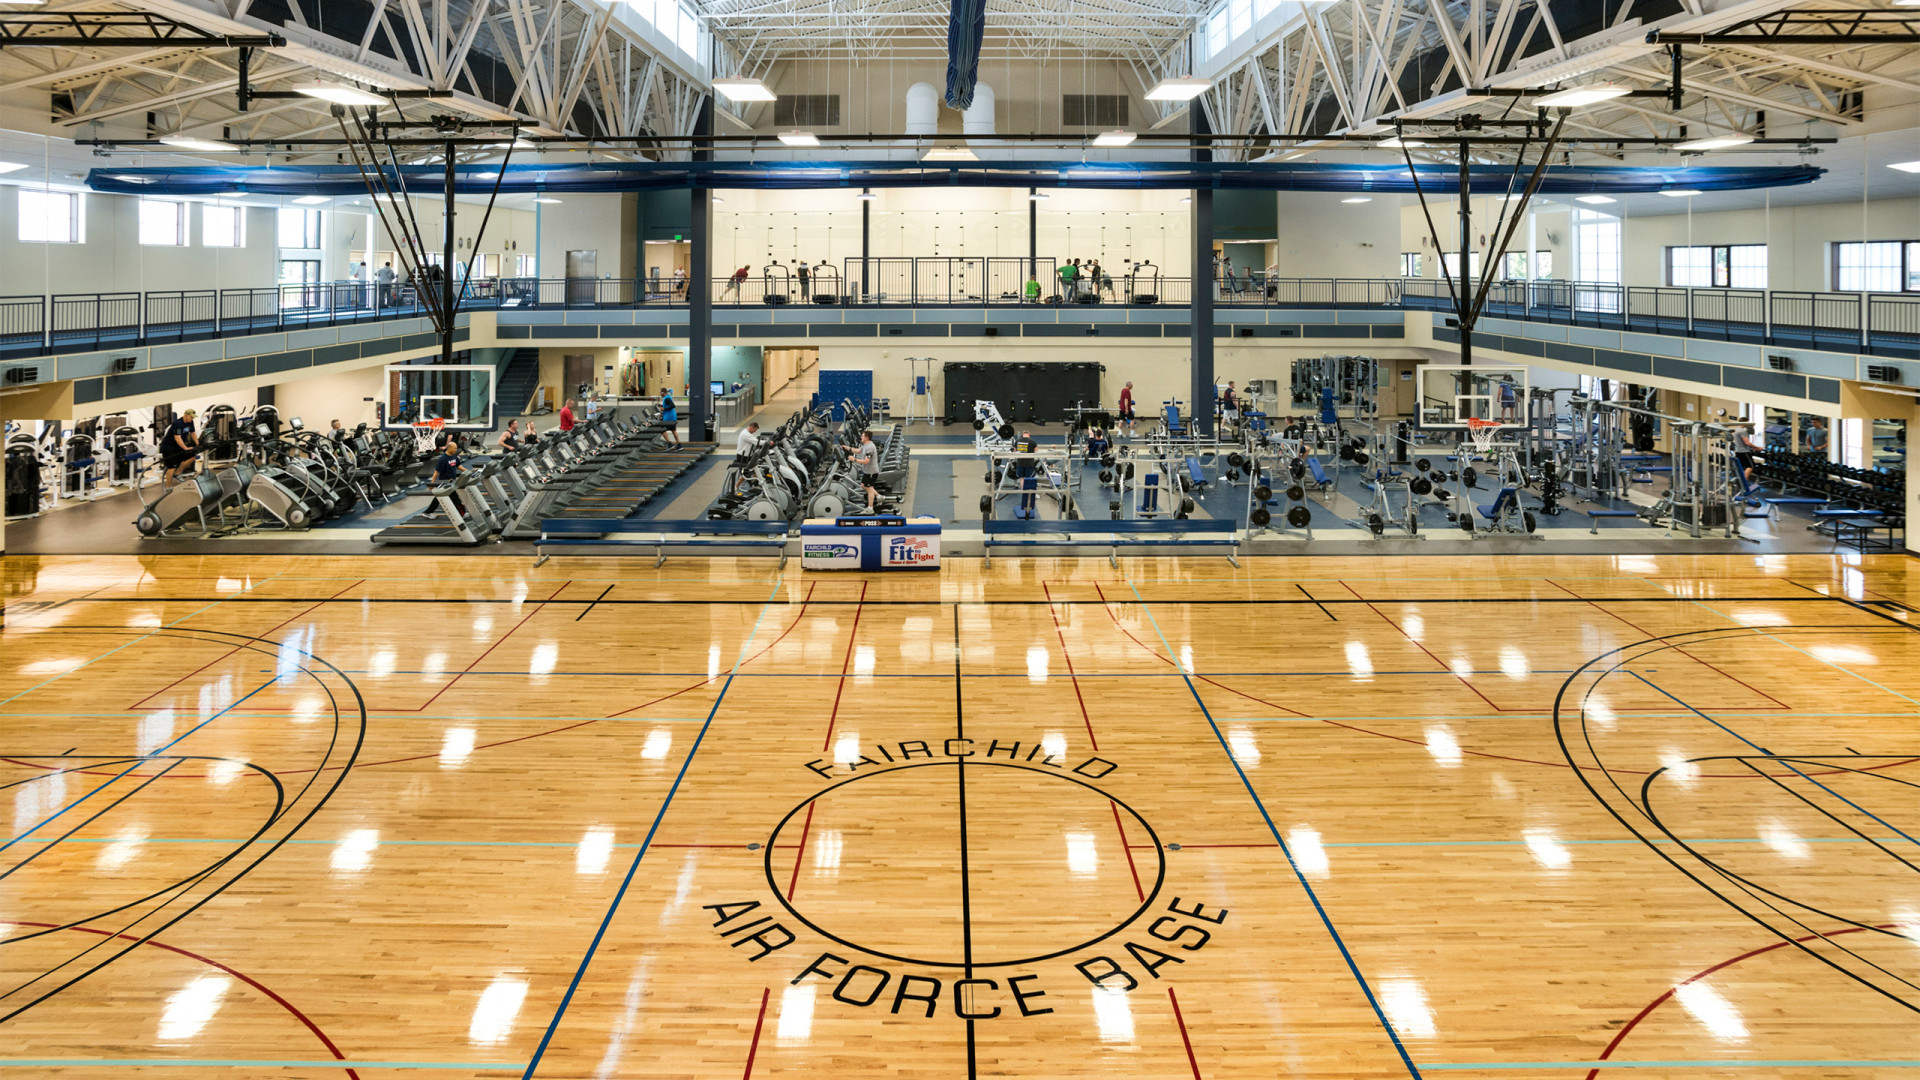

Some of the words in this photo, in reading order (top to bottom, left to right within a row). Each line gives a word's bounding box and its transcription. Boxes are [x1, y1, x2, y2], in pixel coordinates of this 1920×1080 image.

[889, 546, 914, 561] Fit
[914, 553, 934, 561] Fight
[803, 738, 1119, 780] FAIRCHILD
[702, 900, 796, 962] AIR
[790, 952, 1055, 1020] FORCE
[1073, 896, 1229, 995] BASE
